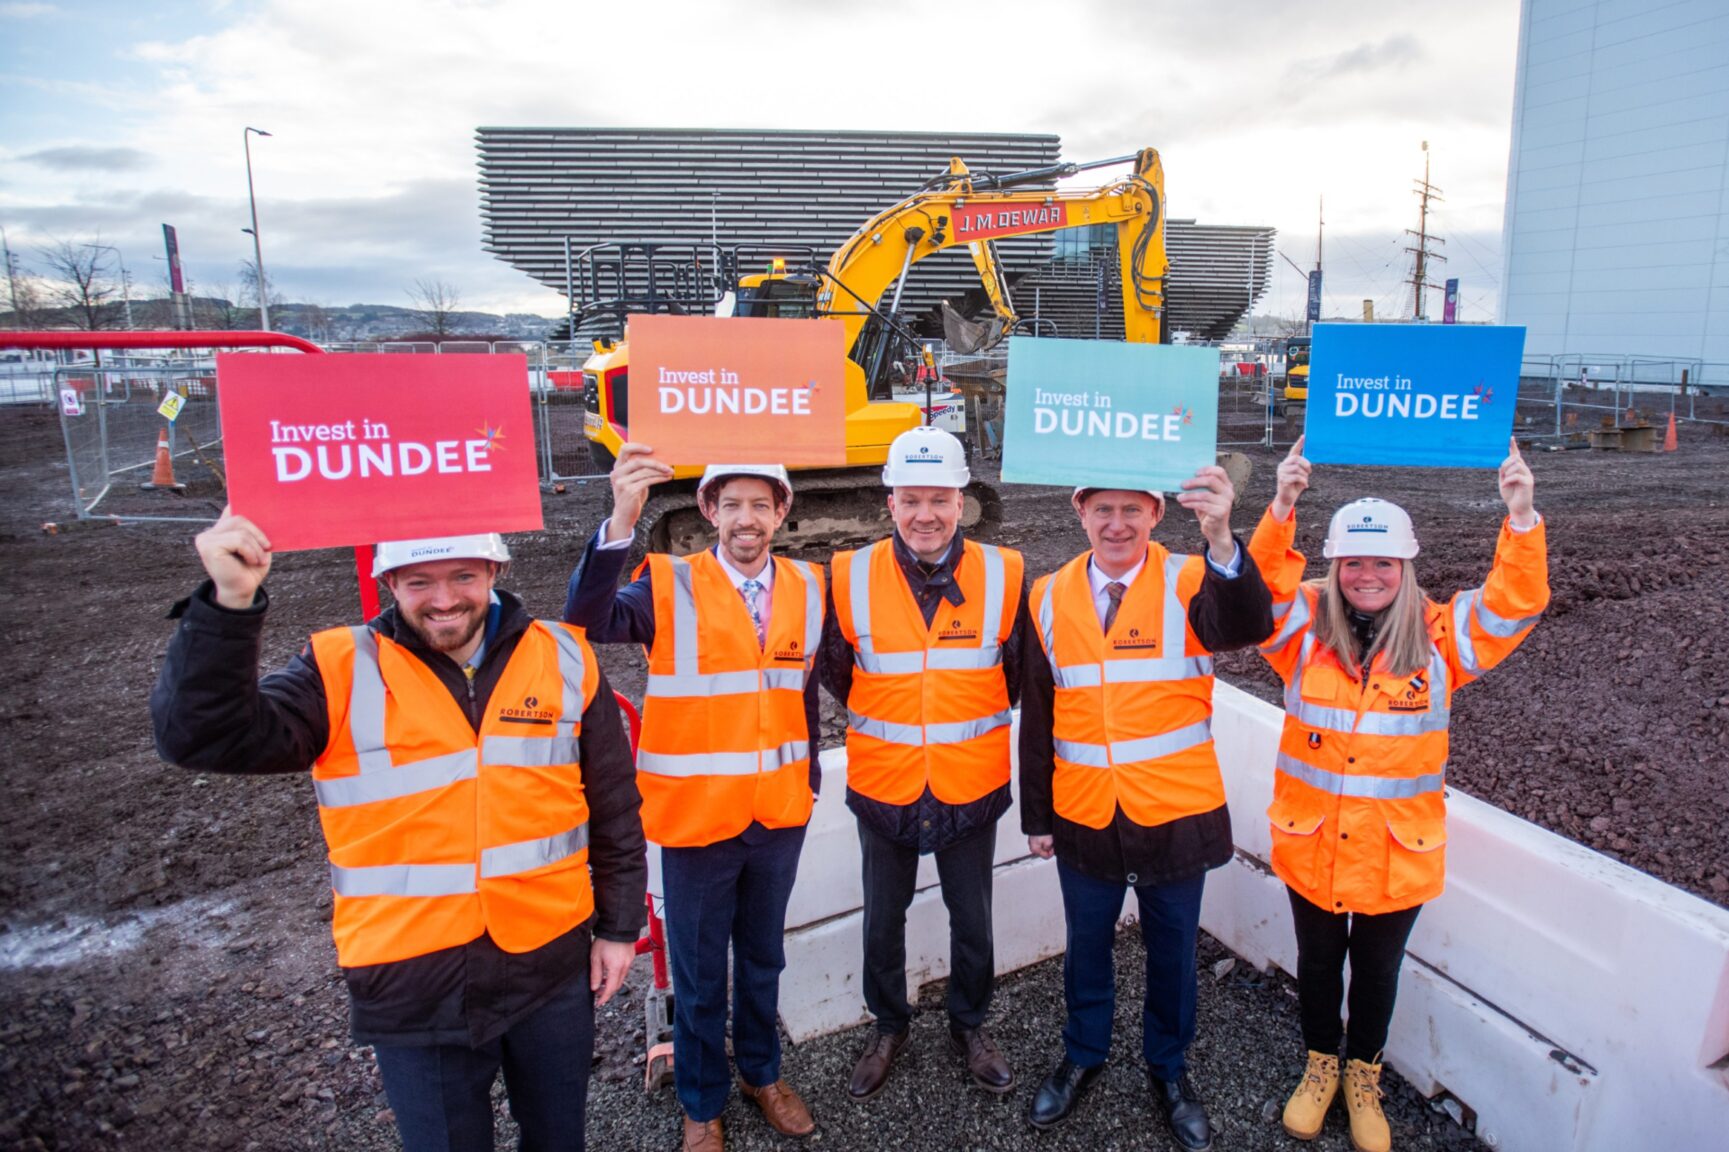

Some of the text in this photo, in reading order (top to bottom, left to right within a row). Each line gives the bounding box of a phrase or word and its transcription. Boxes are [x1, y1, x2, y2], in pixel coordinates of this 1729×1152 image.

[658, 367, 739, 384] Invest in
[1336, 373, 1412, 390] Invest in
[658, 387, 811, 415] DUNDEE
[1035, 388, 1111, 408] Invest in
[1335, 392, 1480, 420] DUNDEE
[270, 418, 390, 442] Invest in
[1034, 407, 1182, 442] DUNDEE
[272, 439, 492, 482] DUNDEE
[500, 708, 554, 718] ROBERTSON
